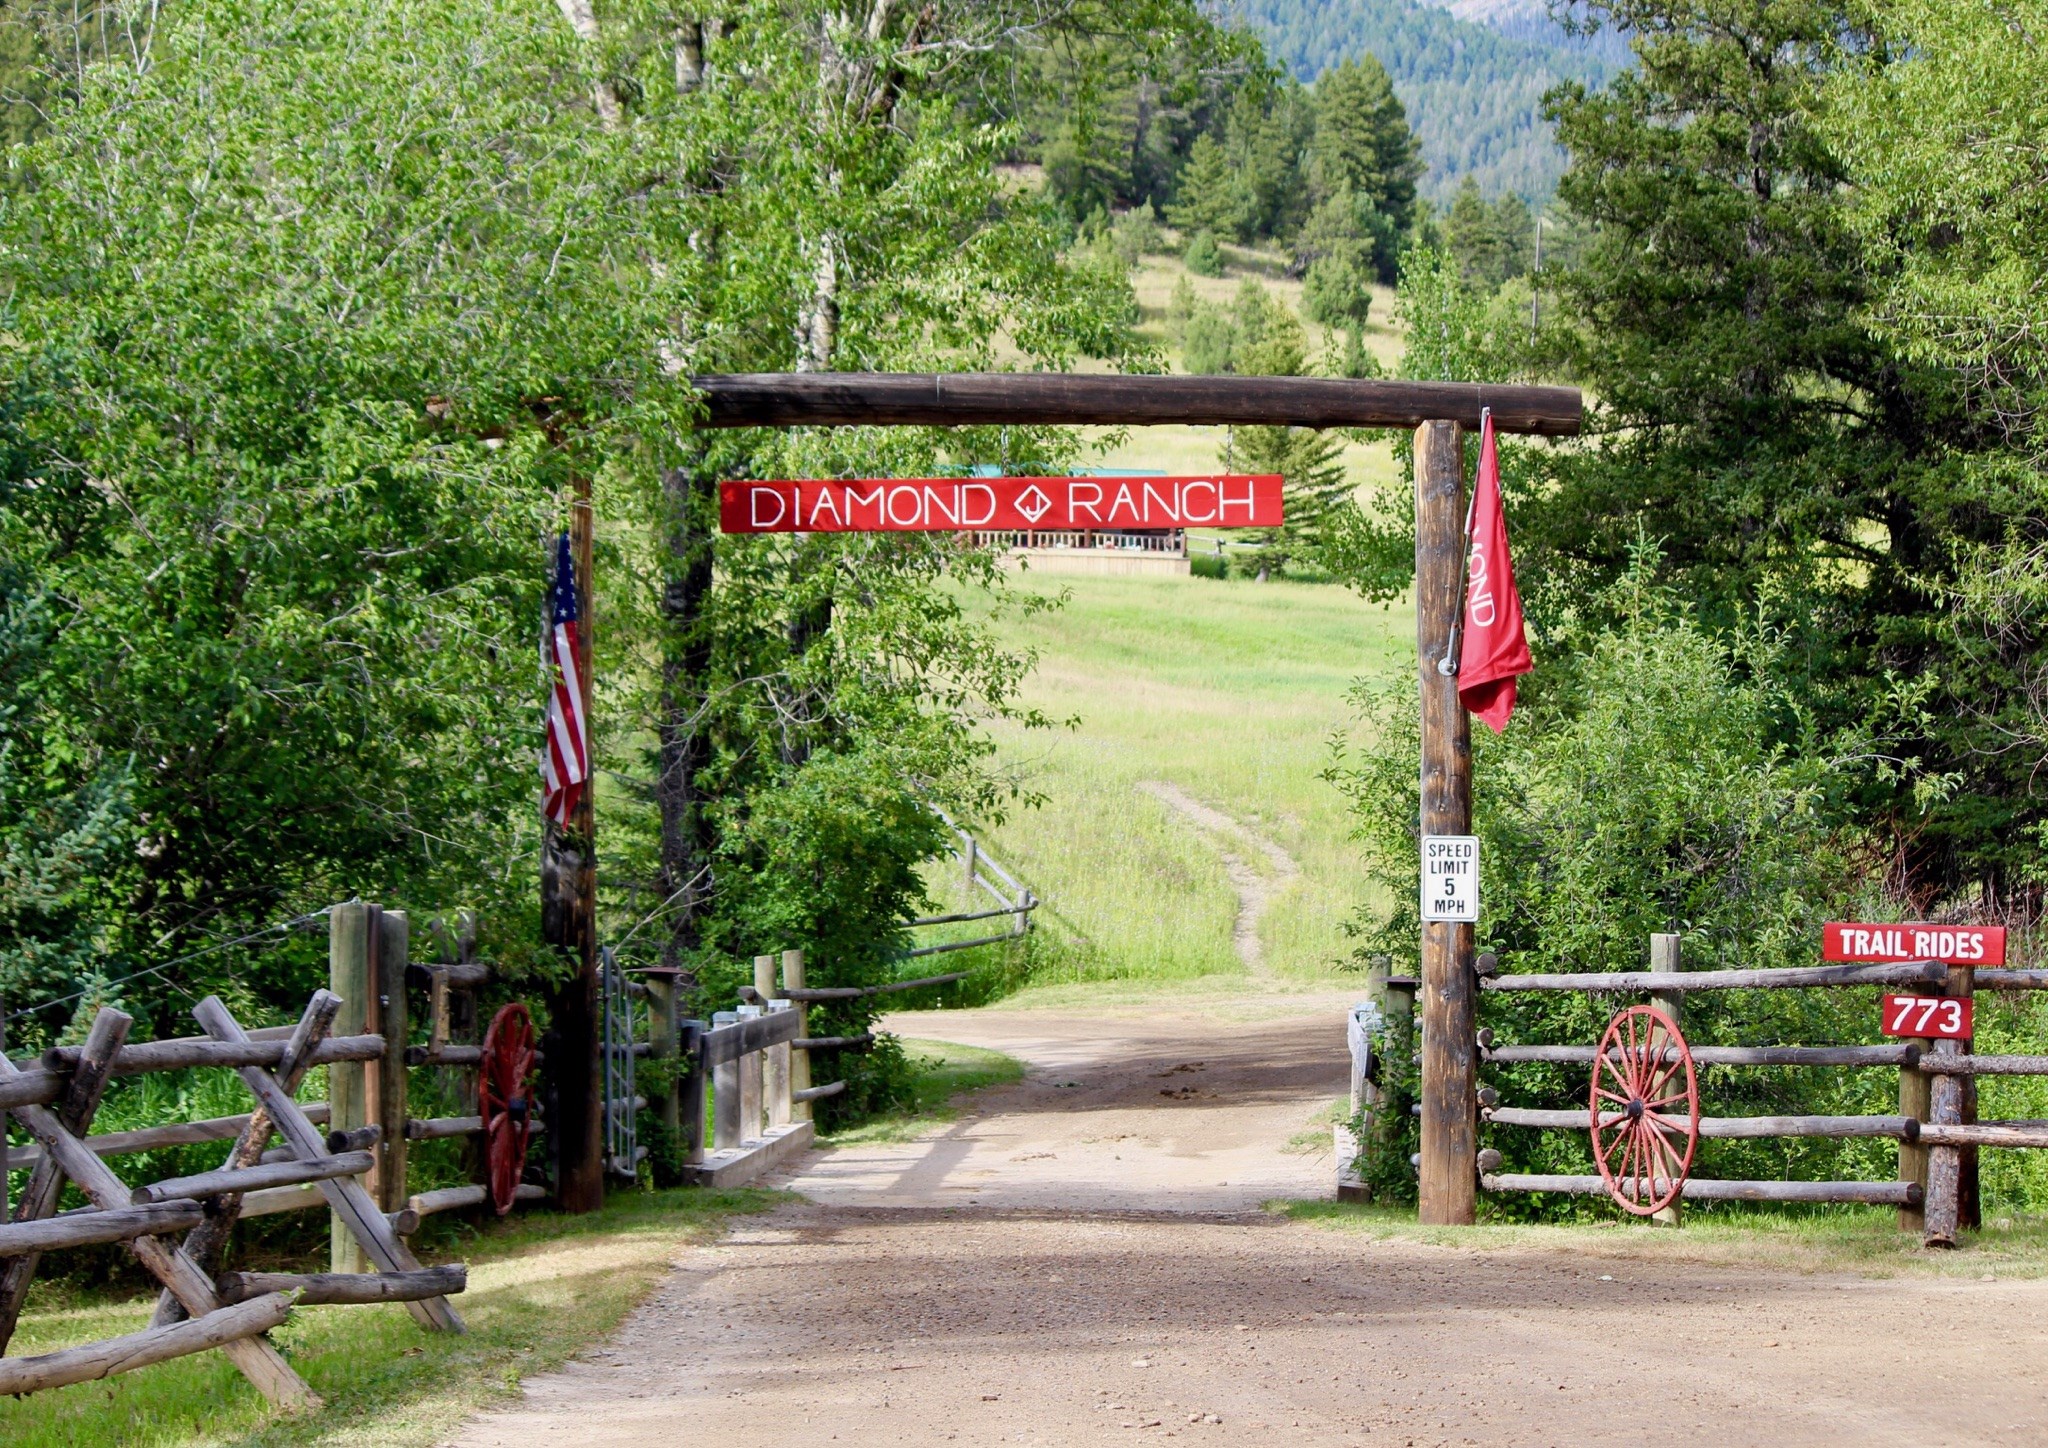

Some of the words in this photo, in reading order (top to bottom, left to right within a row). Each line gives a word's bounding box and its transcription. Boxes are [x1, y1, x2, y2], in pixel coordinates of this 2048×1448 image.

[751, 484, 997, 527] DIAMOND
[1068, 480, 1255, 523] RANCH
[1428, 844, 1472, 858] SPEED
[1430, 861, 1469, 875] LIMIT
[1444, 878, 1455, 896] 5
[1434, 900, 1465, 914] MPH
[1839, 929, 1908, 957] TRAIL
[1915, 931, 1984, 959] RIDES
[1891, 997, 1962, 1034] 773
